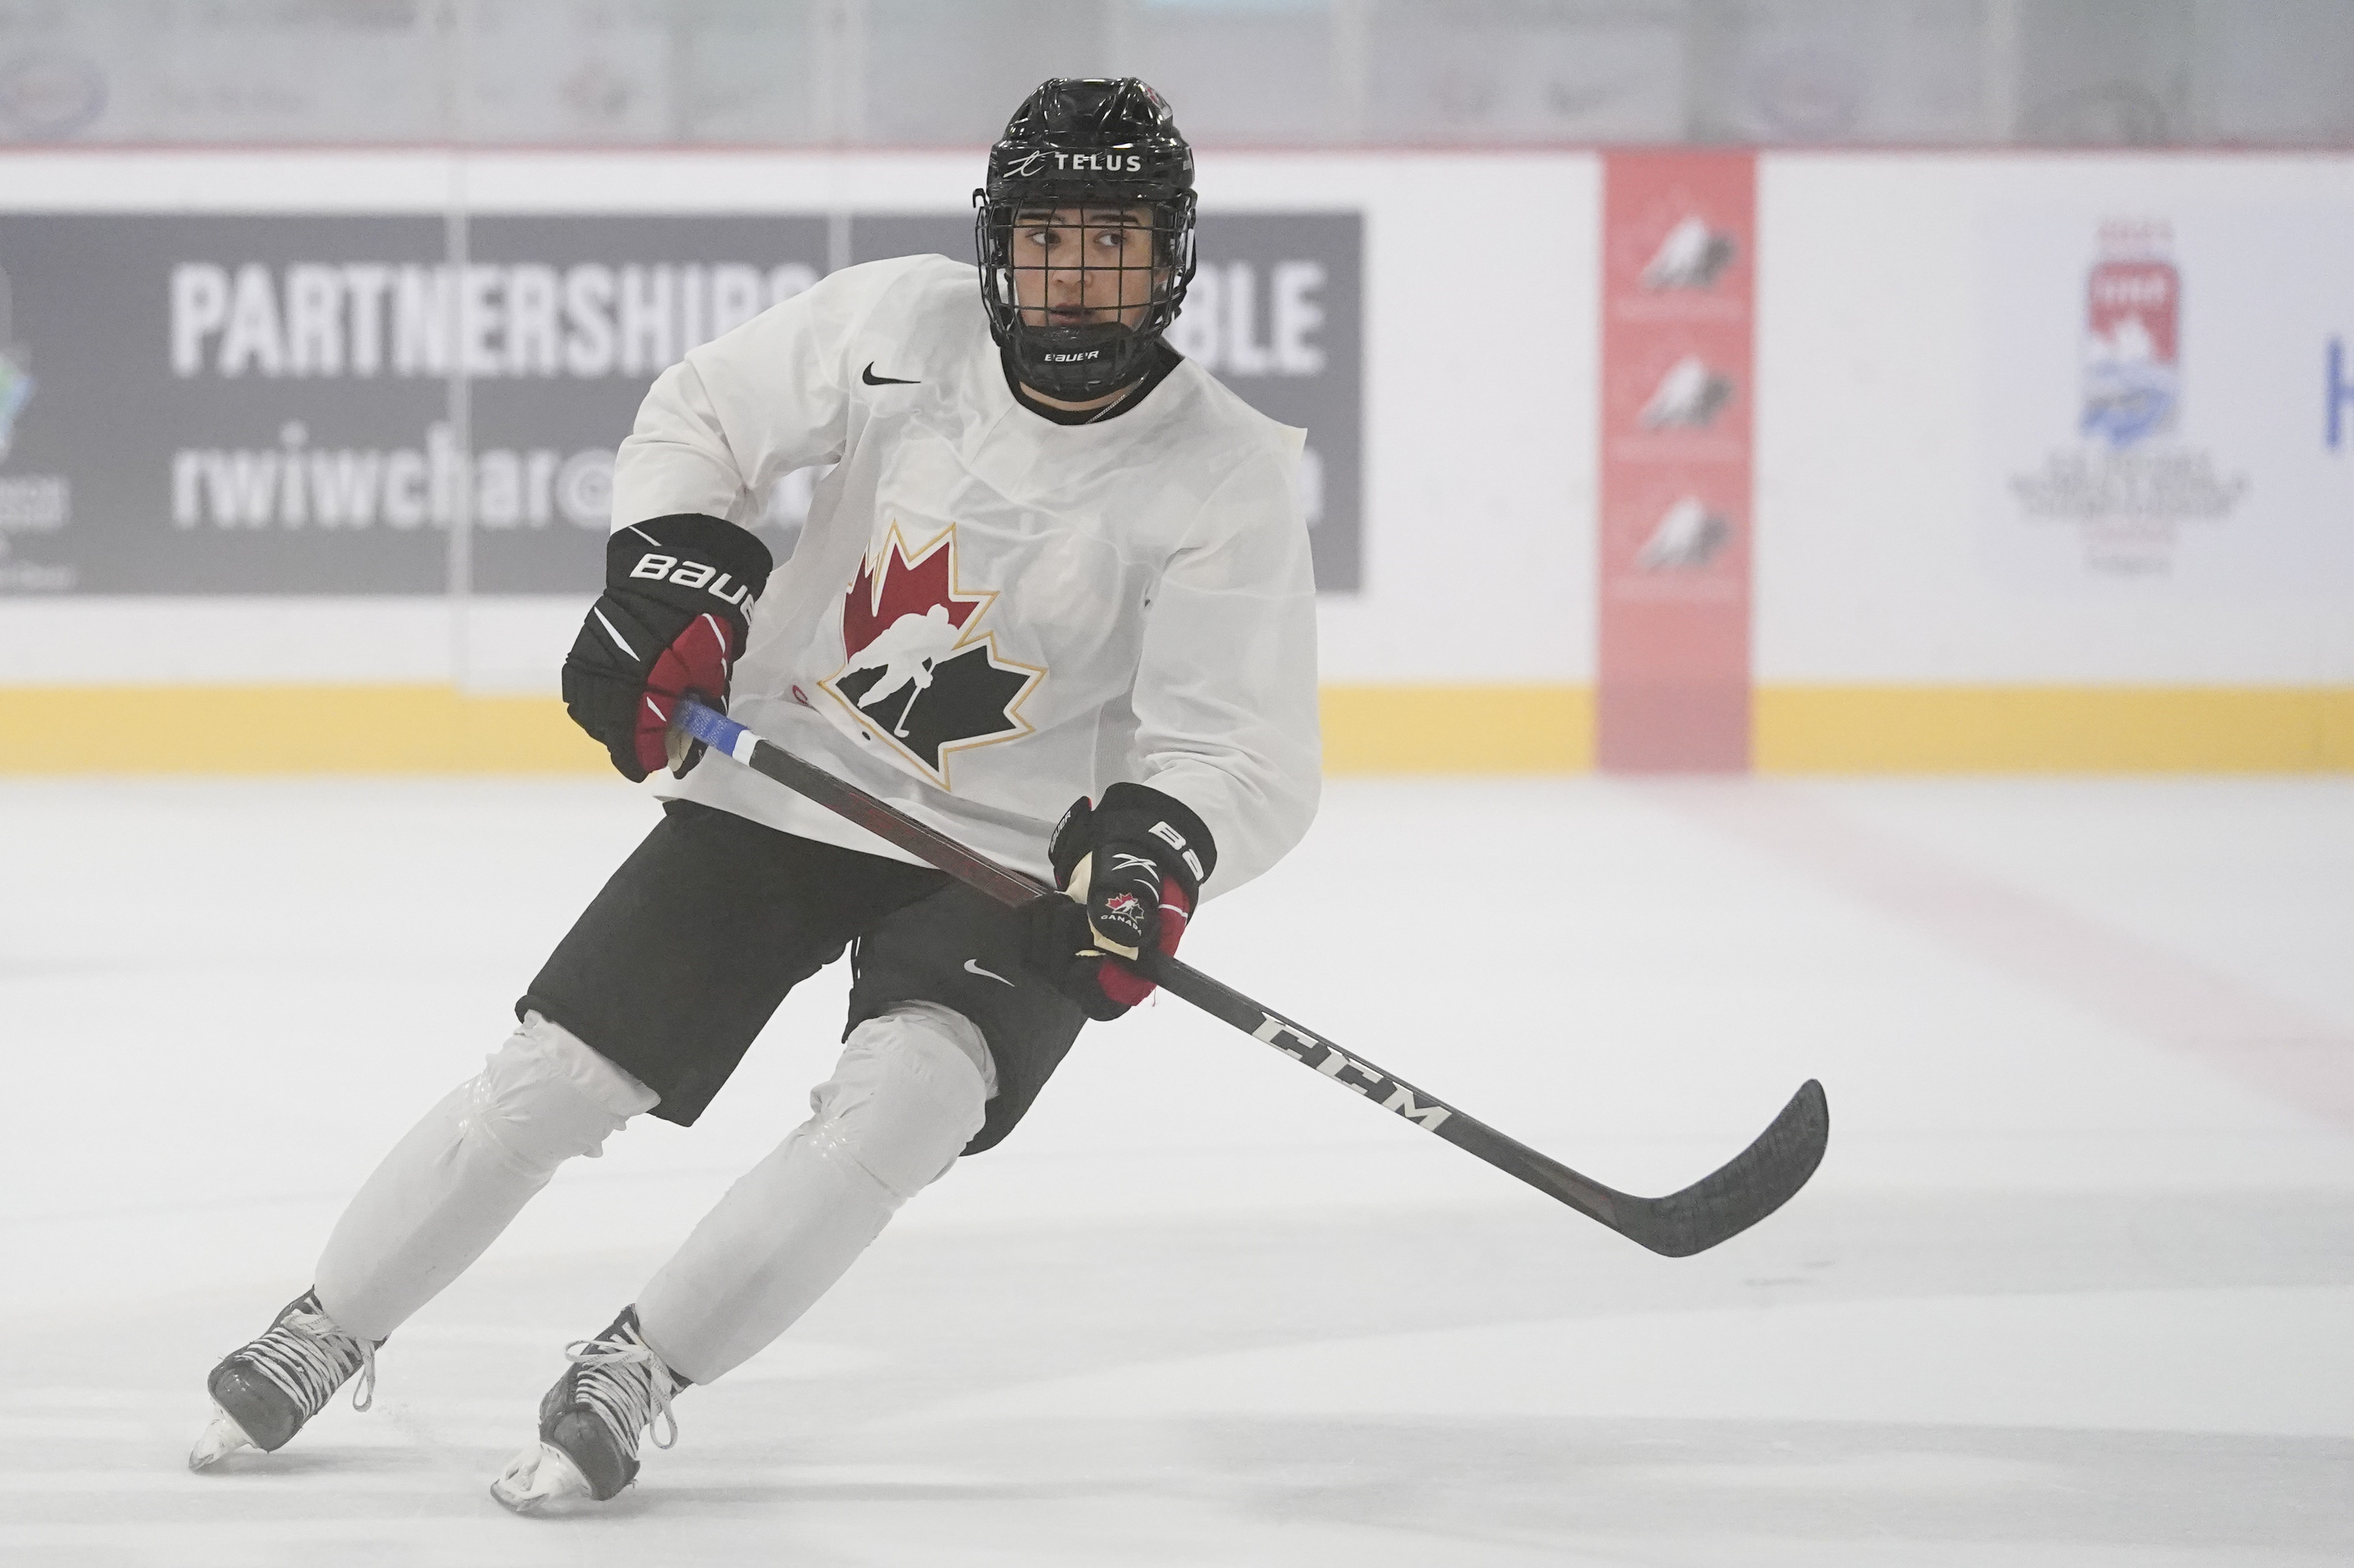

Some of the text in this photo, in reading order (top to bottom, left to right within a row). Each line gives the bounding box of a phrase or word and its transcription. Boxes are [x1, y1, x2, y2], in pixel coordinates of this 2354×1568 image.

[1054, 153, 1142, 172] TELUS
[1101, 914, 1142, 937] CANADA
[1251, 1011, 1452, 1132] CCM
